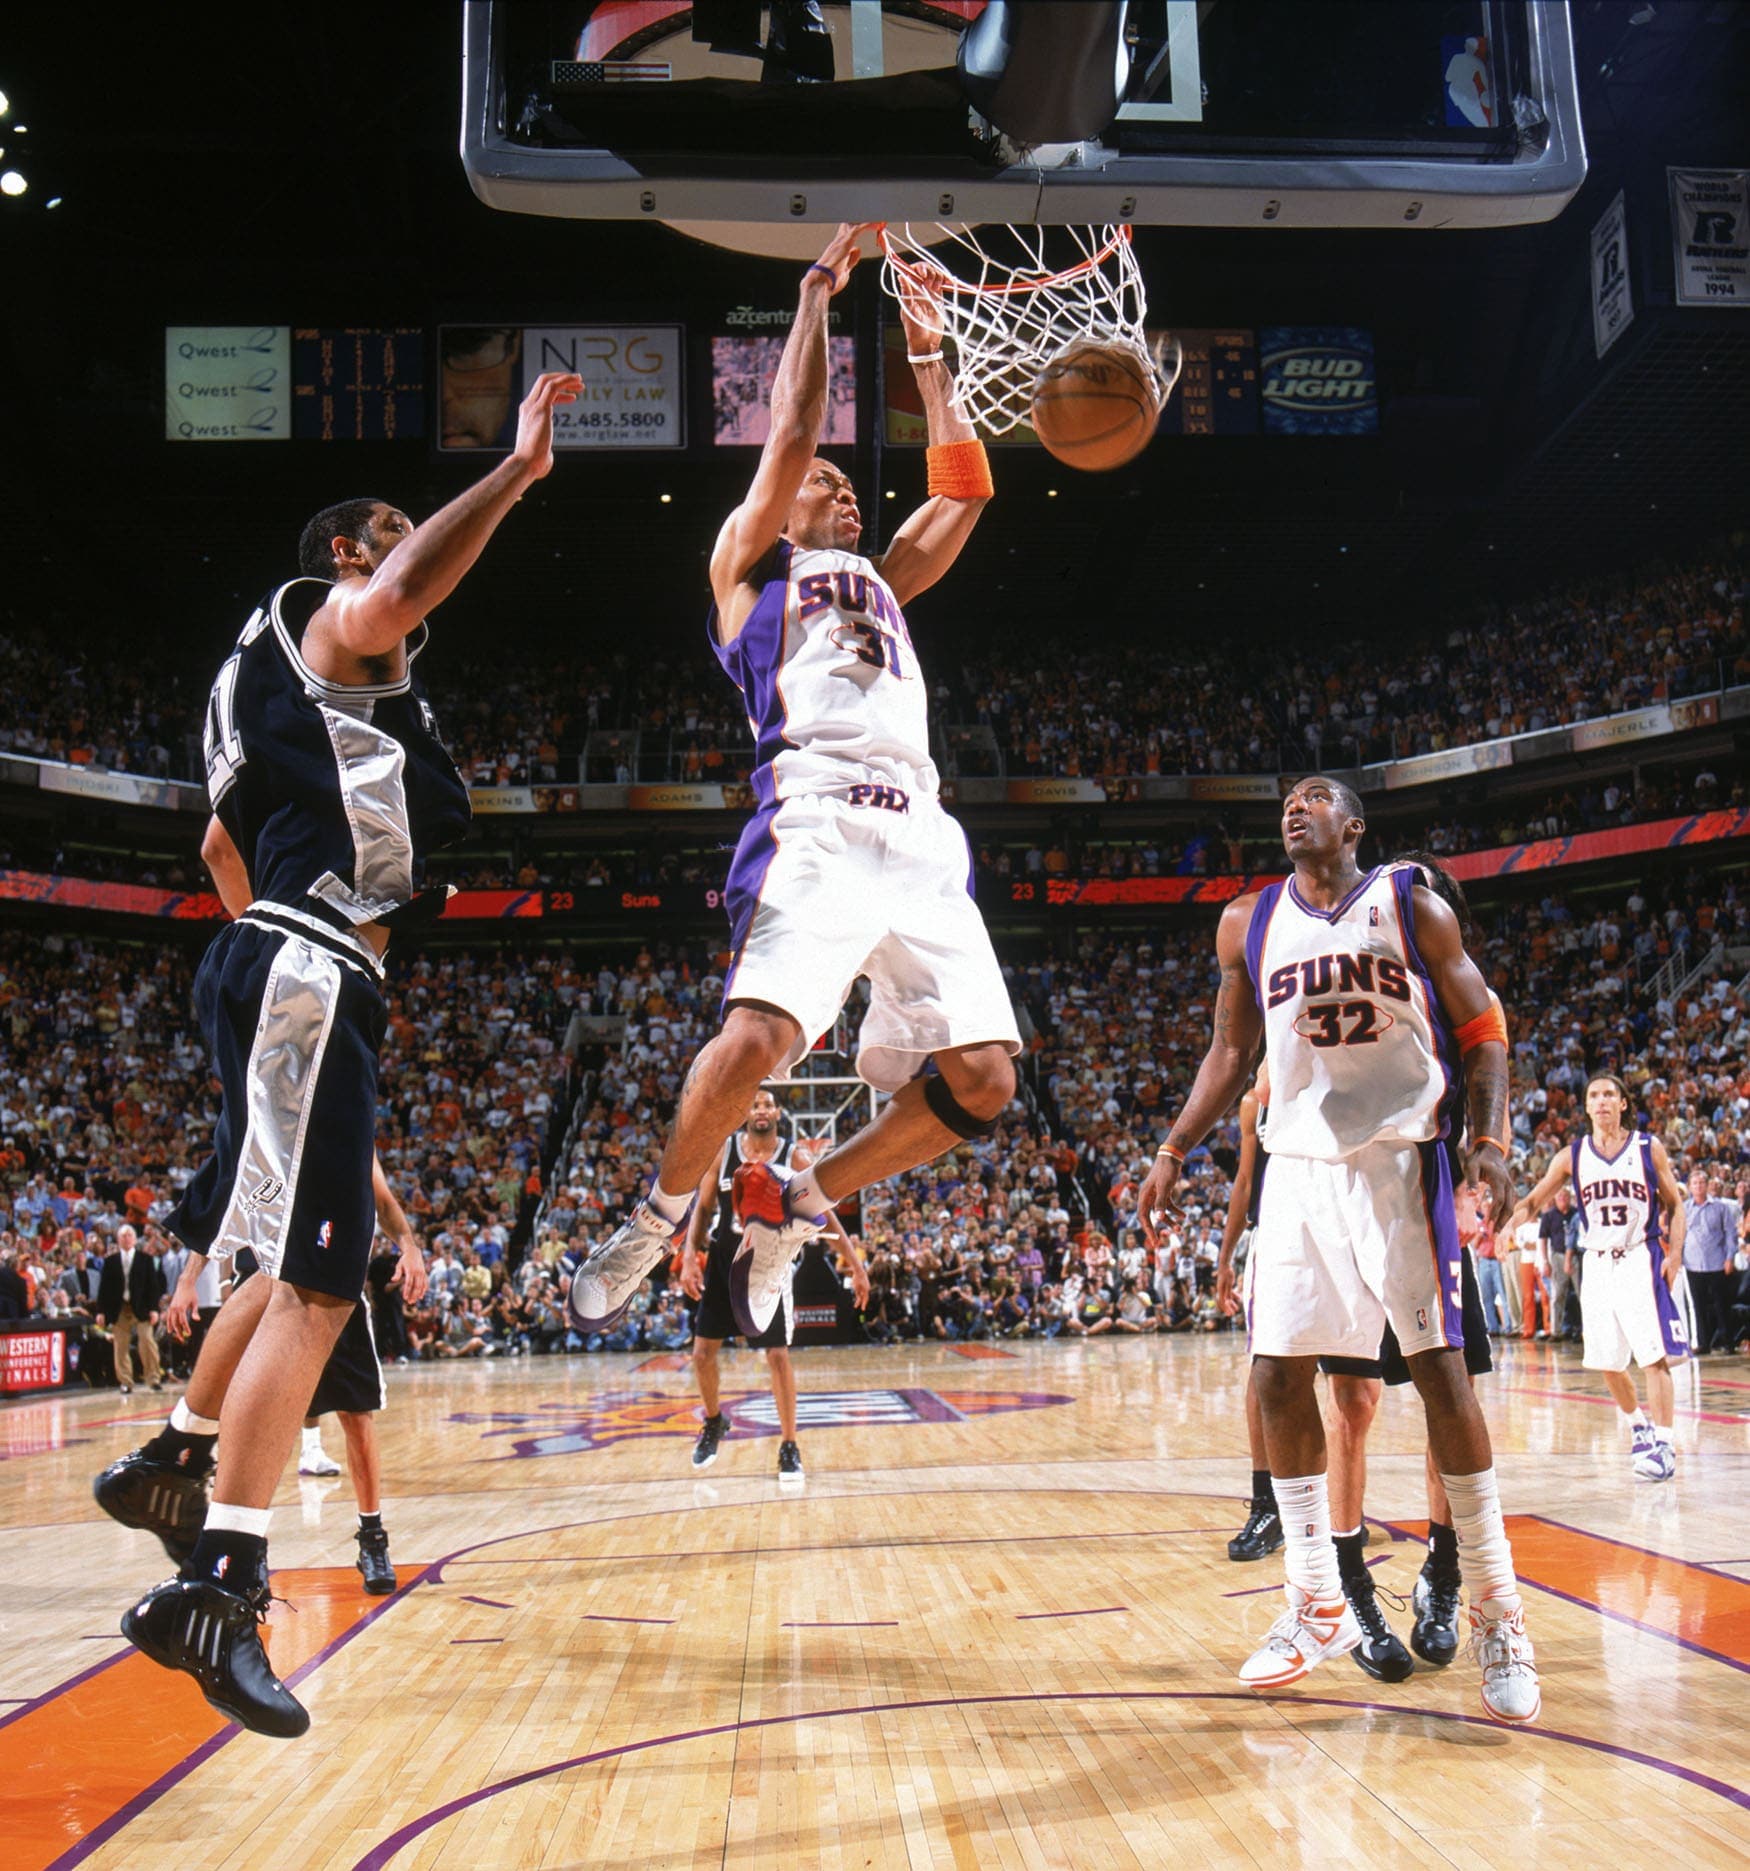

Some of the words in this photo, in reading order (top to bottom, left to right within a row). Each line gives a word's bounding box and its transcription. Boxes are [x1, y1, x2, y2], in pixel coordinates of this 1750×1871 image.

[1705, 283, 1735, 295] 1994
[179, 342, 238, 360] Qwest
[541, 336, 663, 373] NRG
[1281, 358, 1364, 378] BUD
[179, 382, 238, 399] Qwest
[624, 388, 665, 400] LAW
[1262, 379, 1375, 399] LIGHT
[552, 412, 665, 427] 02.485.5800
[179, 421, 238, 438] Qwest
[798, 572, 914, 651] SUN
[1583, 718, 1659, 740] MAJERLE
[649, 792, 703, 802] ADAMS
[849, 784, 909, 813] PHX
[1032, 786, 1077, 796] DAVIS
[474, 796, 523, 806] WKINS
[550, 891, 575, 910] 23
[621, 892, 661, 908] Suns
[1011, 883, 1035, 901] 23
[1268, 953, 1412, 1010] SUNS
[1308, 1000, 1379, 1047] 32
[1582, 1180, 1648, 1206] SUNS
[1600, 1205, 1628, 1227] 13
